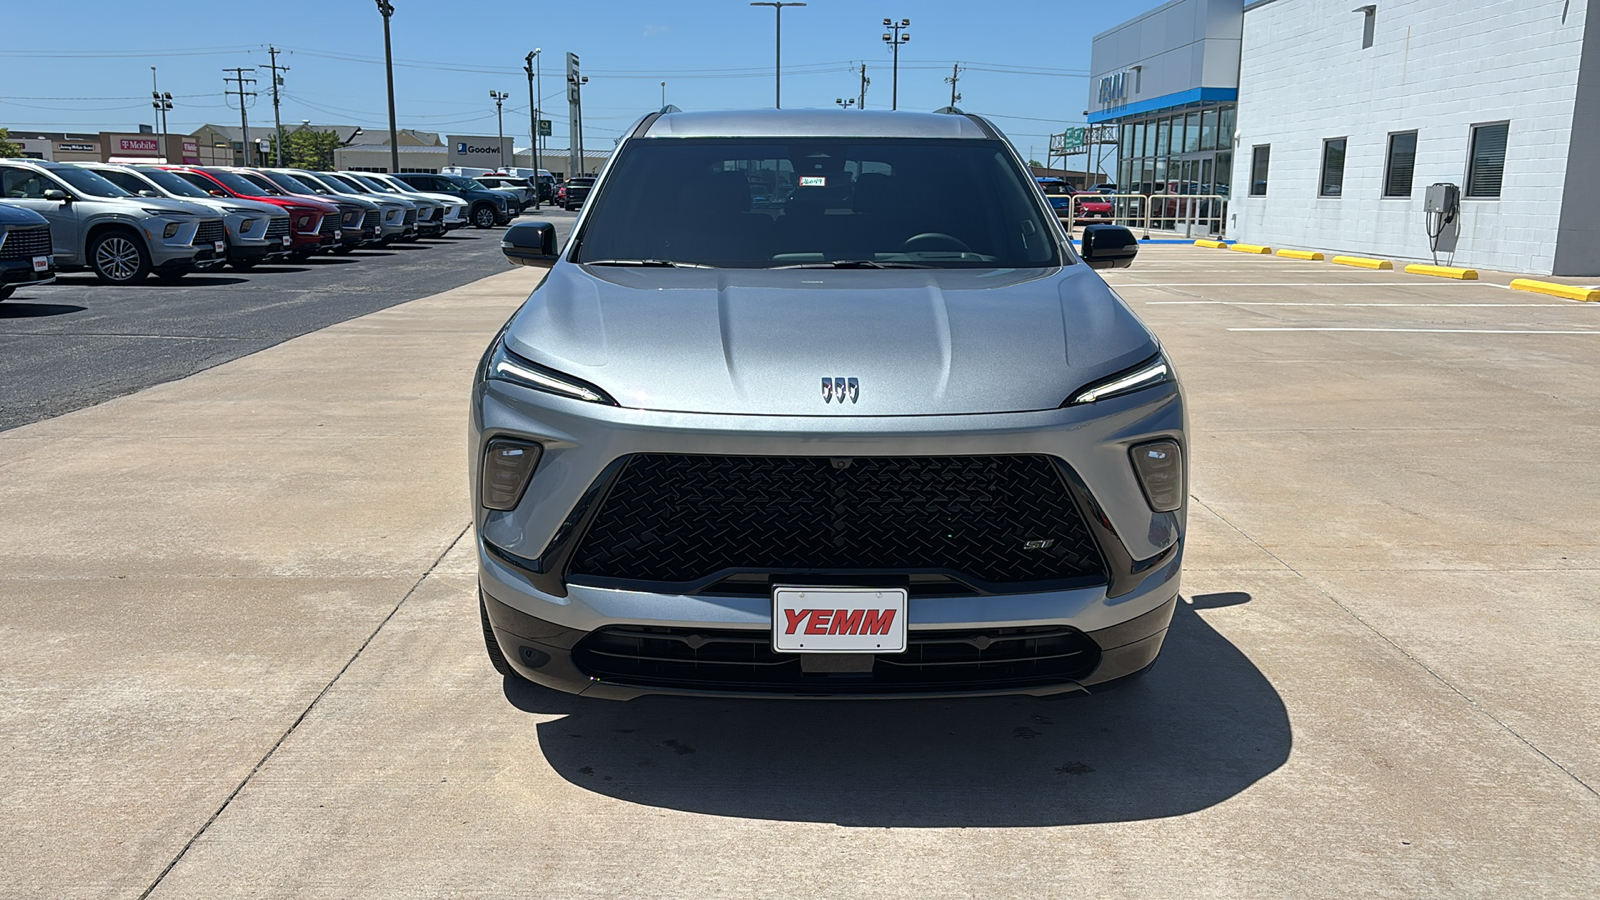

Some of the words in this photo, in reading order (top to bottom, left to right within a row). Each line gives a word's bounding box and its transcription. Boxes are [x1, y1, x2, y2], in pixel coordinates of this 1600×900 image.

[468, 146, 501, 154] Goodwi
[1023, 538, 1055, 550] ST
[783, 608, 897, 636] YEMM
